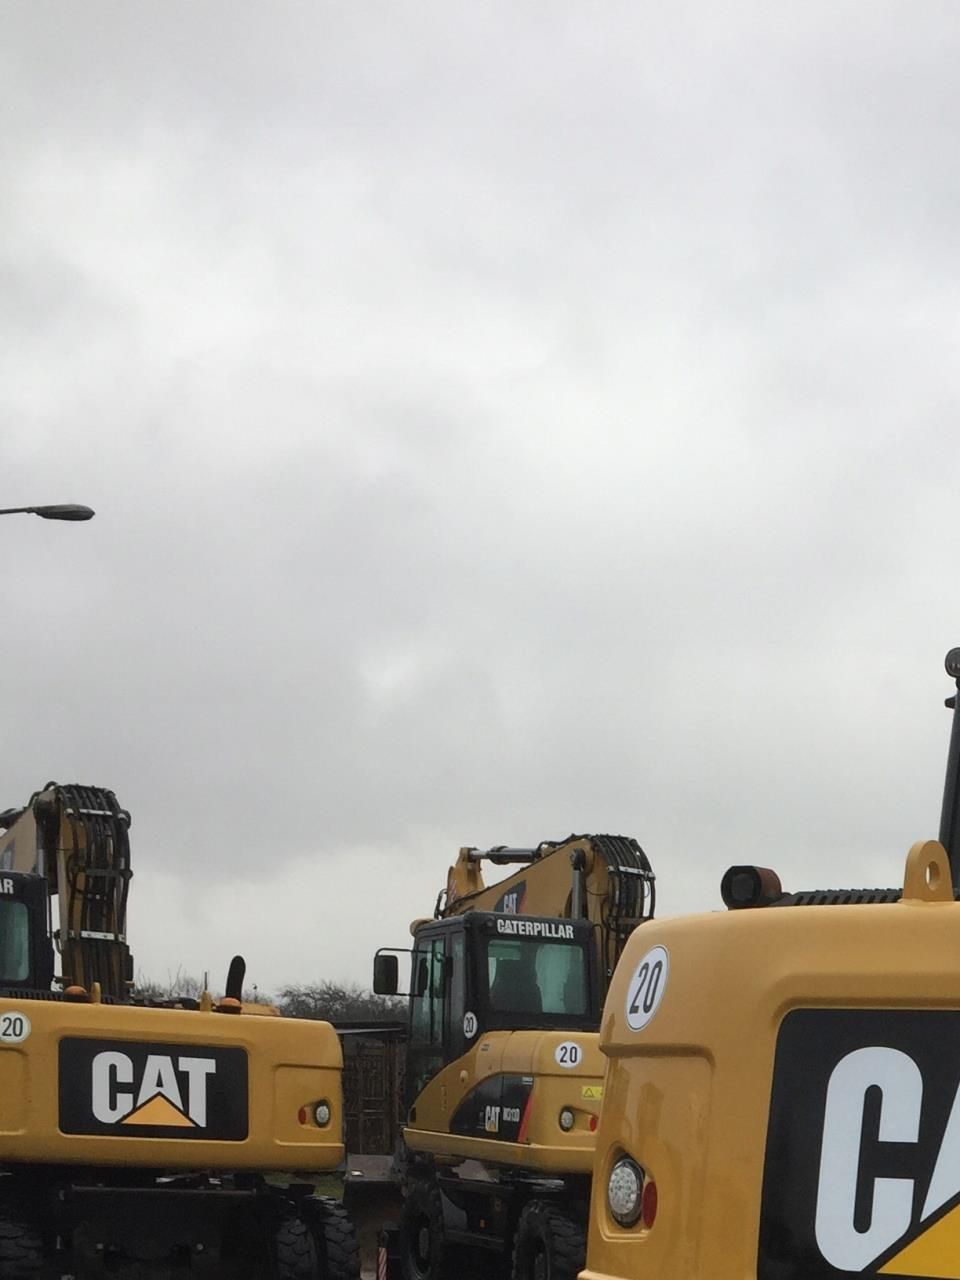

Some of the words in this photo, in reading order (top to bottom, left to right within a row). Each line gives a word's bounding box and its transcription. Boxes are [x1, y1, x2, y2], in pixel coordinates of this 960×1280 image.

[497, 919, 574, 939] CATERPILLAR
[628, 960, 663, 1014] 20
[2, 1017, 24, 1037] 20
[465, 1016, 474, 1034] 20
[559, 1046, 578, 1064] 20
[92, 1051, 216, 1128] CAT
[485, 1105, 501, 1133] CAT
